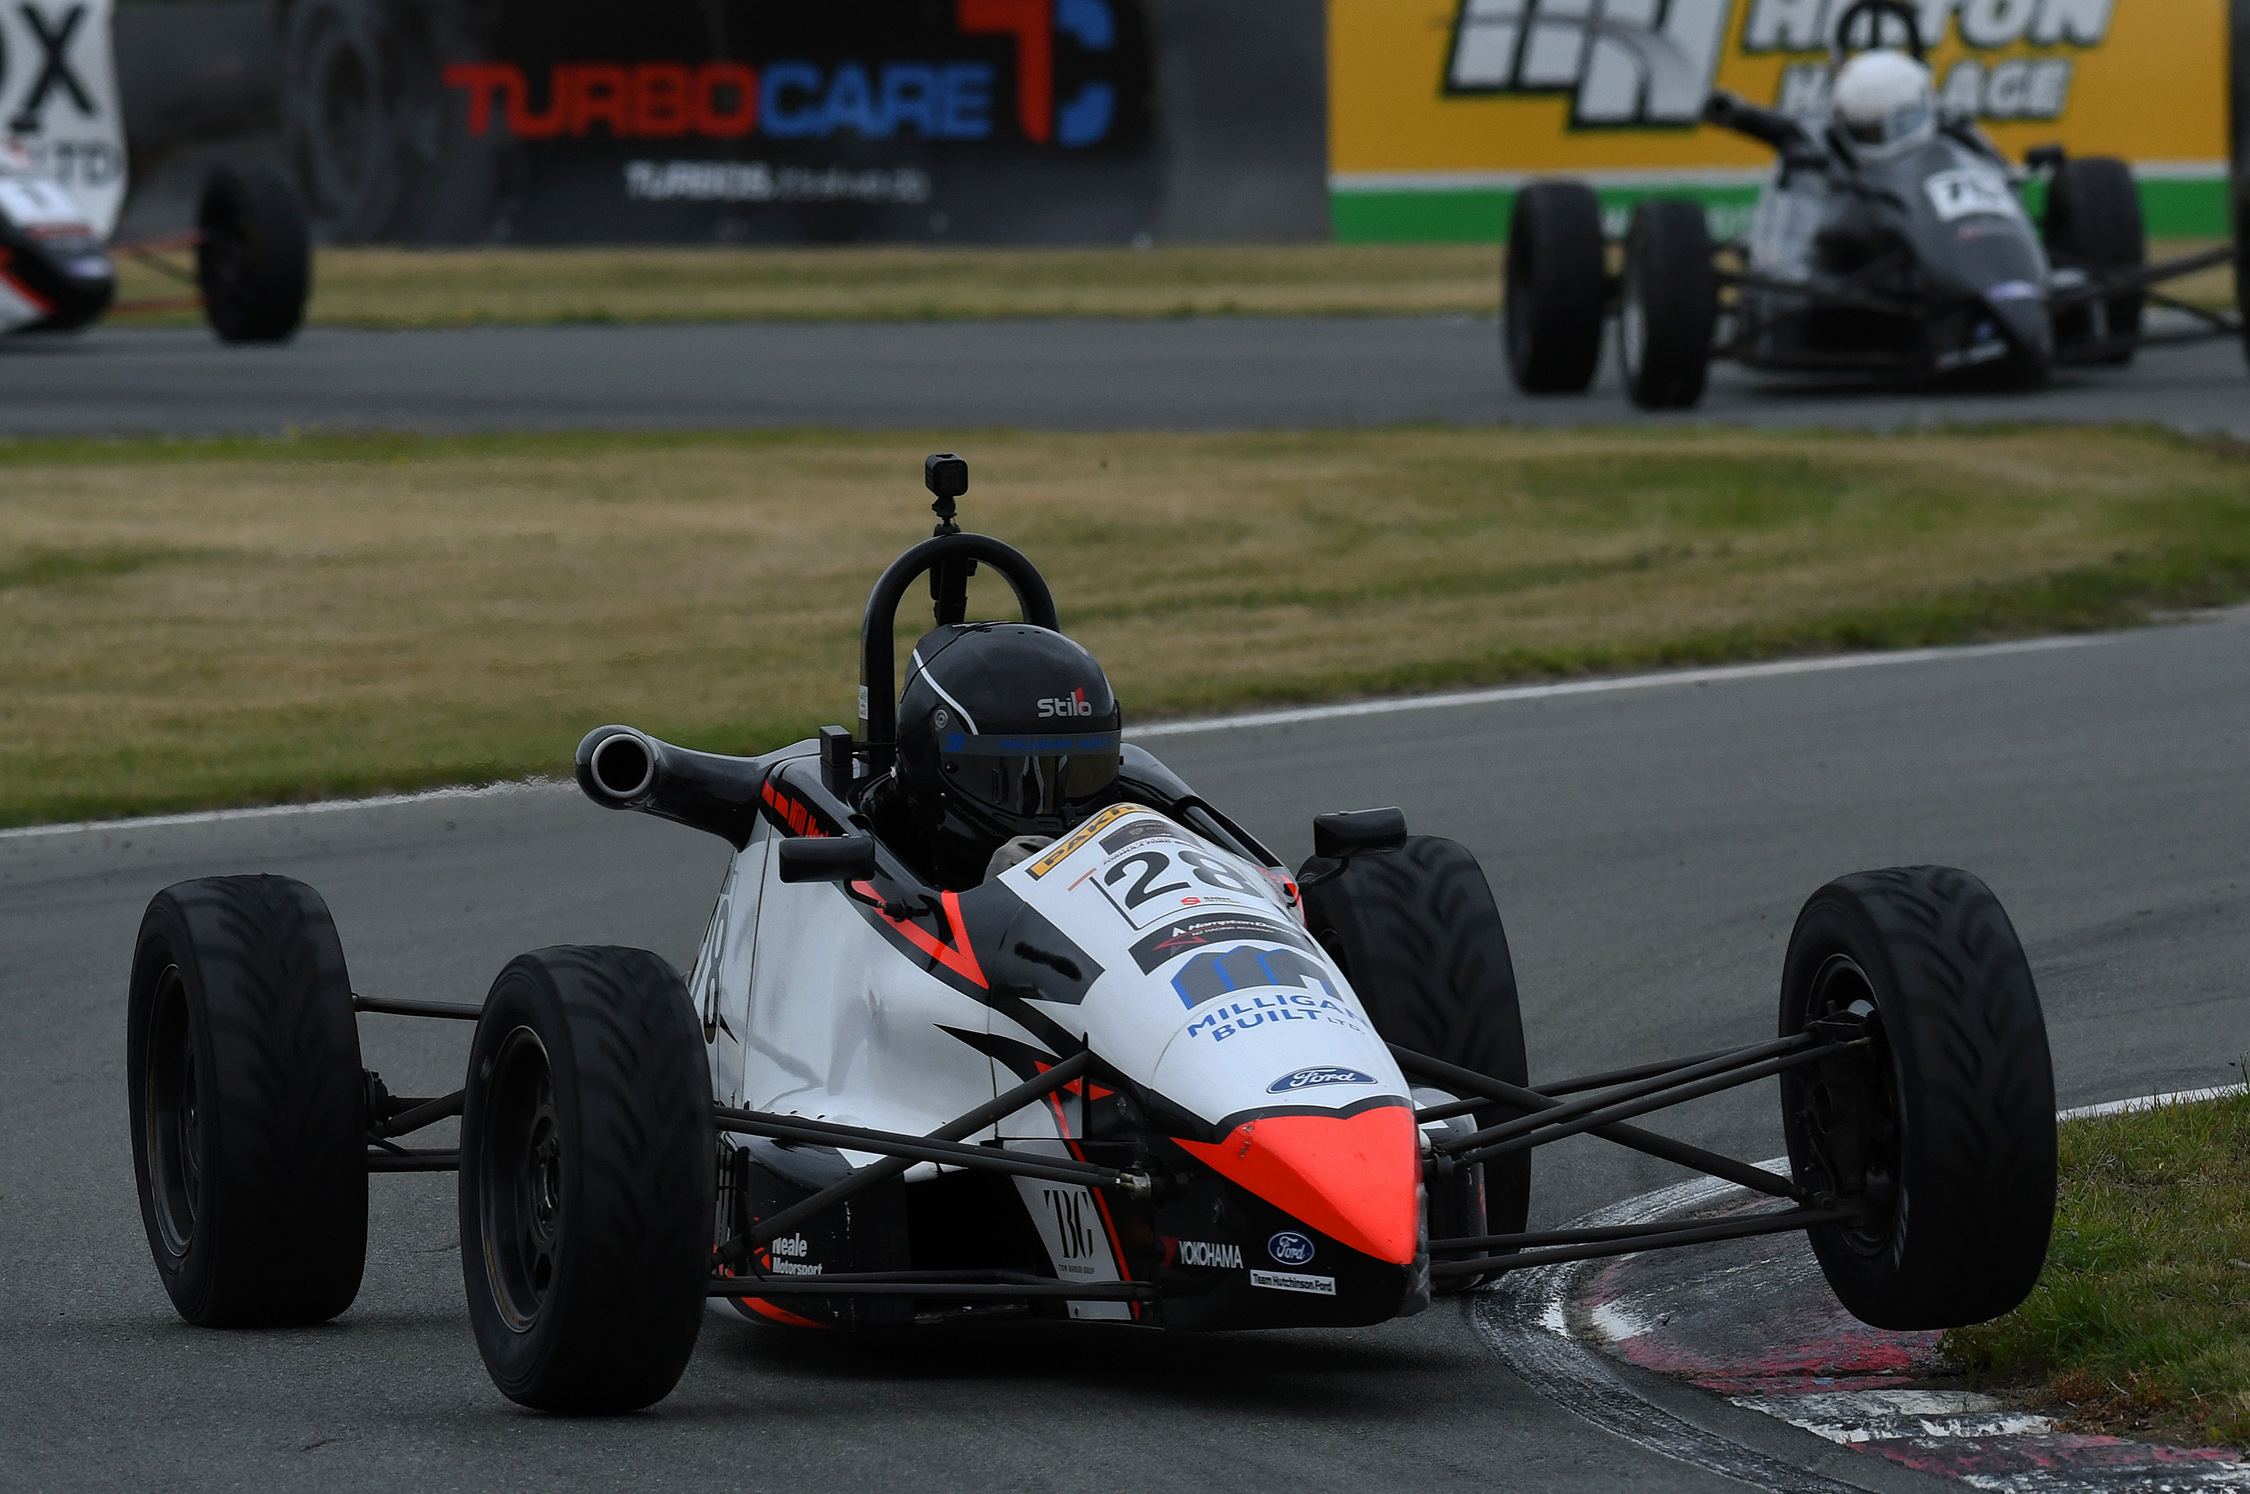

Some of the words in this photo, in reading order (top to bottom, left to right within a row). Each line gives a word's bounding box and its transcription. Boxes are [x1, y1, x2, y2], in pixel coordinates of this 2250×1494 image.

[443, 61, 995, 138] TURBOCARE
[1778, 57, 2073, 119] HAGE
[1036, 686, 1093, 719] Stilo
[1103, 850, 1266, 911] 28
[1187, 994, 1370, 1039] MILLIGAN
[1211, 1008, 1322, 1043] BUILT
[1289, 1067, 1357, 1089] Ford
[1178, 1240, 1245, 1270] YOKOHAMA
[1276, 1235, 1307, 1261] Ford
[772, 1256, 823, 1276] Motorsport
[1252, 1272, 1272, 1286] Team
[1273, 1275, 1315, 1290] Hutchinson
[1315, 1279, 1333, 1292] Ford
